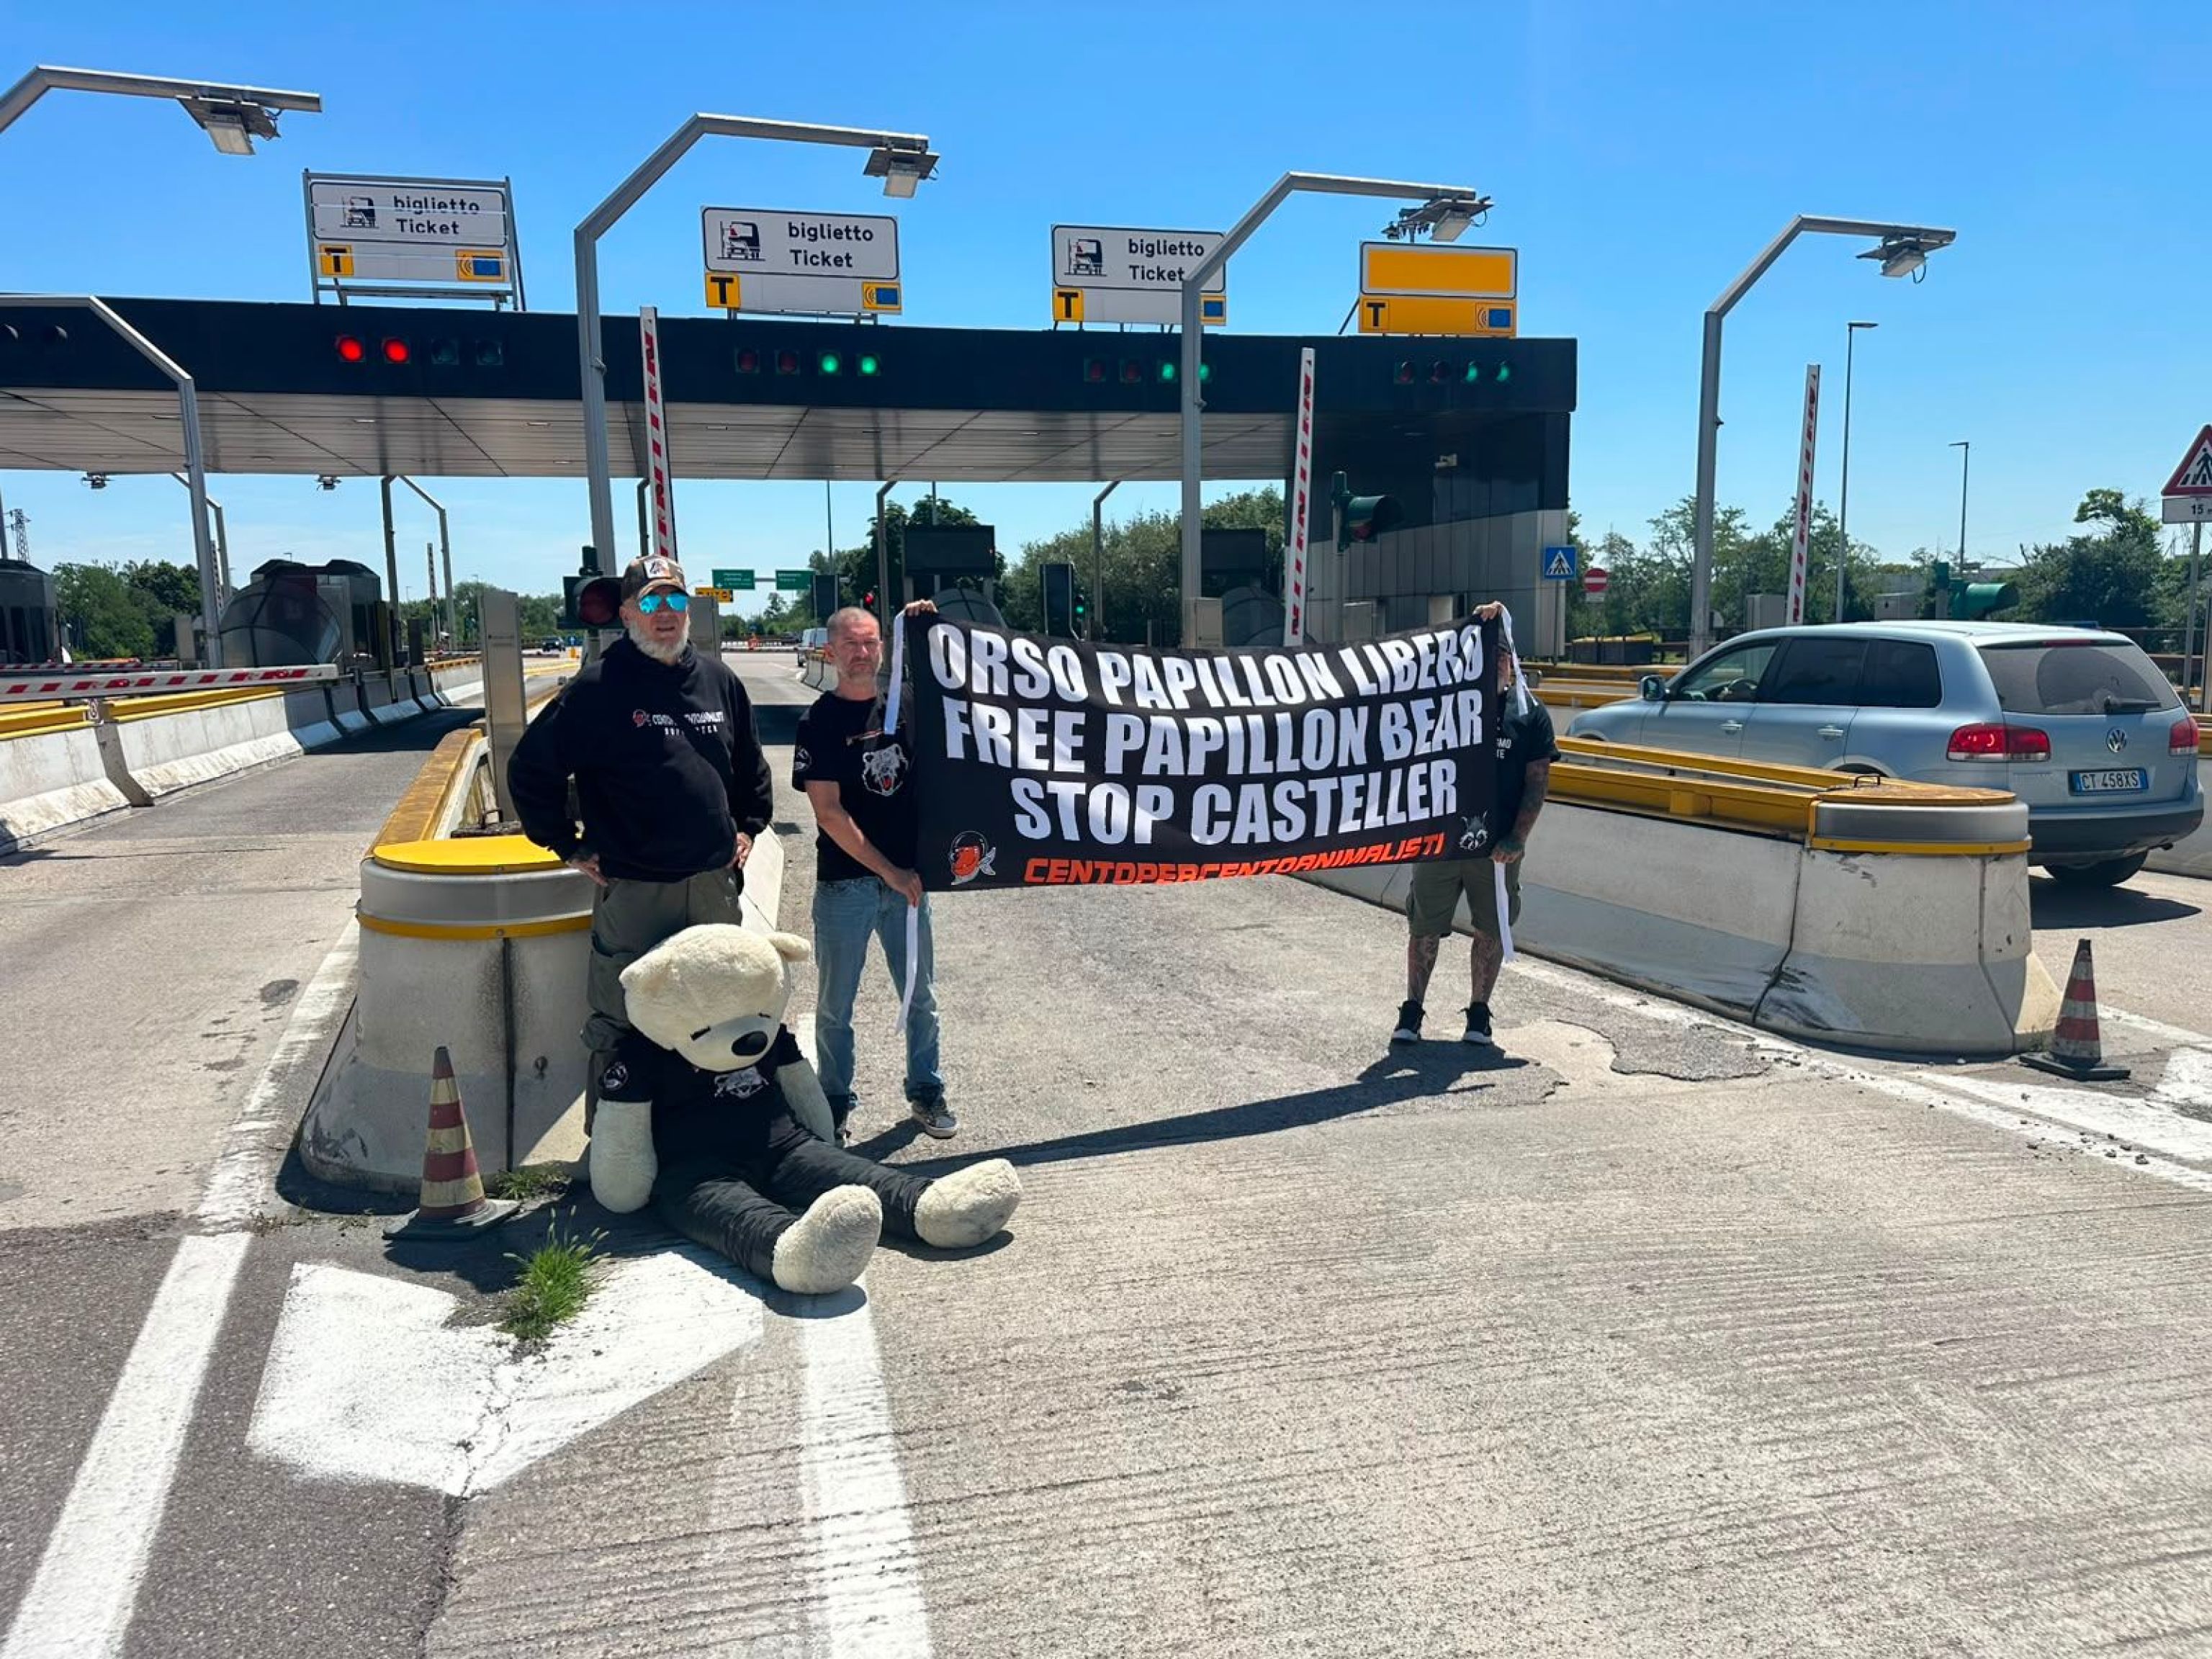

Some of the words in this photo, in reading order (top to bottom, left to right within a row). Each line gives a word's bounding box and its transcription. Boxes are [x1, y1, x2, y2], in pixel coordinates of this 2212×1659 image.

[393, 195, 480, 215] biglietto
[395, 218, 459, 235] Ticket
[788, 222, 873, 242] biglietto
[1128, 238, 1205, 257] biglietto
[324, 247, 348, 273] T
[790, 249, 853, 268] Ticket
[1128, 264, 1185, 282] Ticket
[710, 276, 734, 304] T
[1057, 292, 1079, 318] T
[1367, 302, 1385, 327] T
[2192, 504, 2204, 515] 15
[928, 623, 1089, 703] ORSO
[1097, 651, 1343, 710] PAPILLON
[1346, 624, 1485, 696] LIBERO
[943, 696, 1085, 773] FREE
[1105, 706, 1368, 775] PAPILLON
[1380, 688, 1483, 761] BEAR
[2081, 773, 2096, 789] CT
[2101, 772, 2139, 787] 458XS
[1010, 778, 1174, 845] STOP
[1190, 759, 1457, 845] CASTELLER
